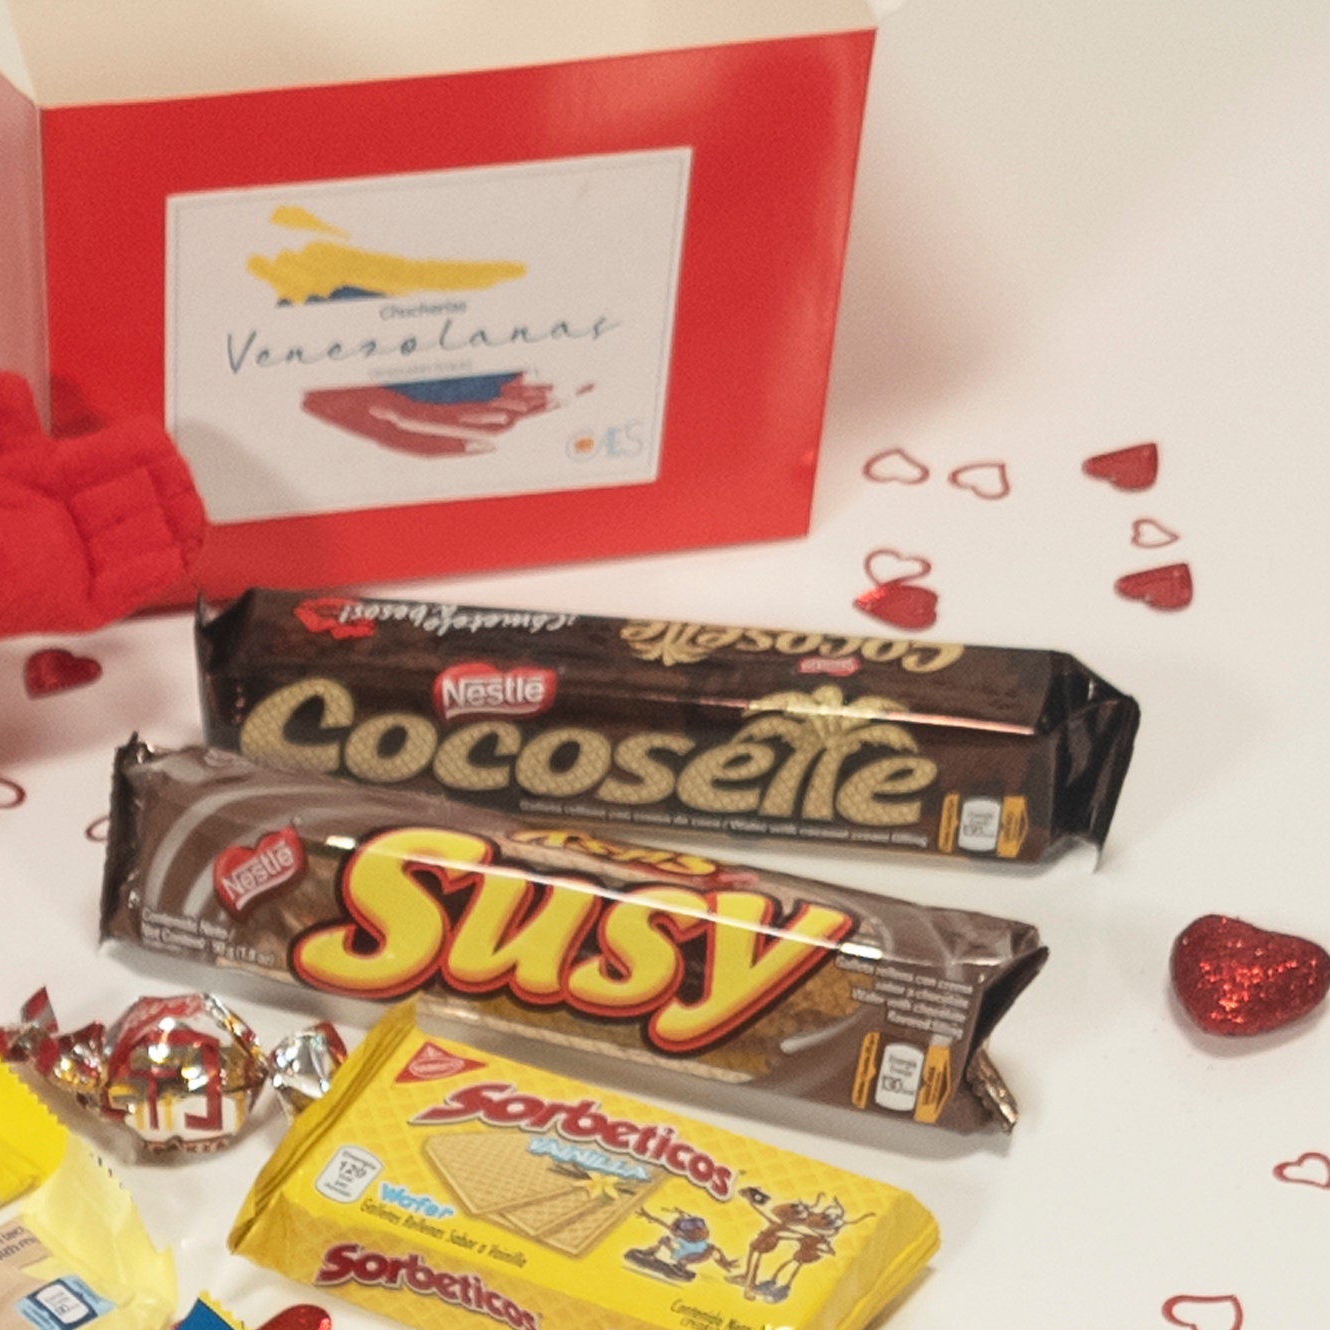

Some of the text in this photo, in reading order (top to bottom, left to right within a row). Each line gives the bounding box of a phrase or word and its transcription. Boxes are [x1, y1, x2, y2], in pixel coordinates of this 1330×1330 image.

[298, 828, 851, 1048] Susy
[413, 1083, 734, 1200] Sorbeticos
[380, 1183, 456, 1219] Wafer
